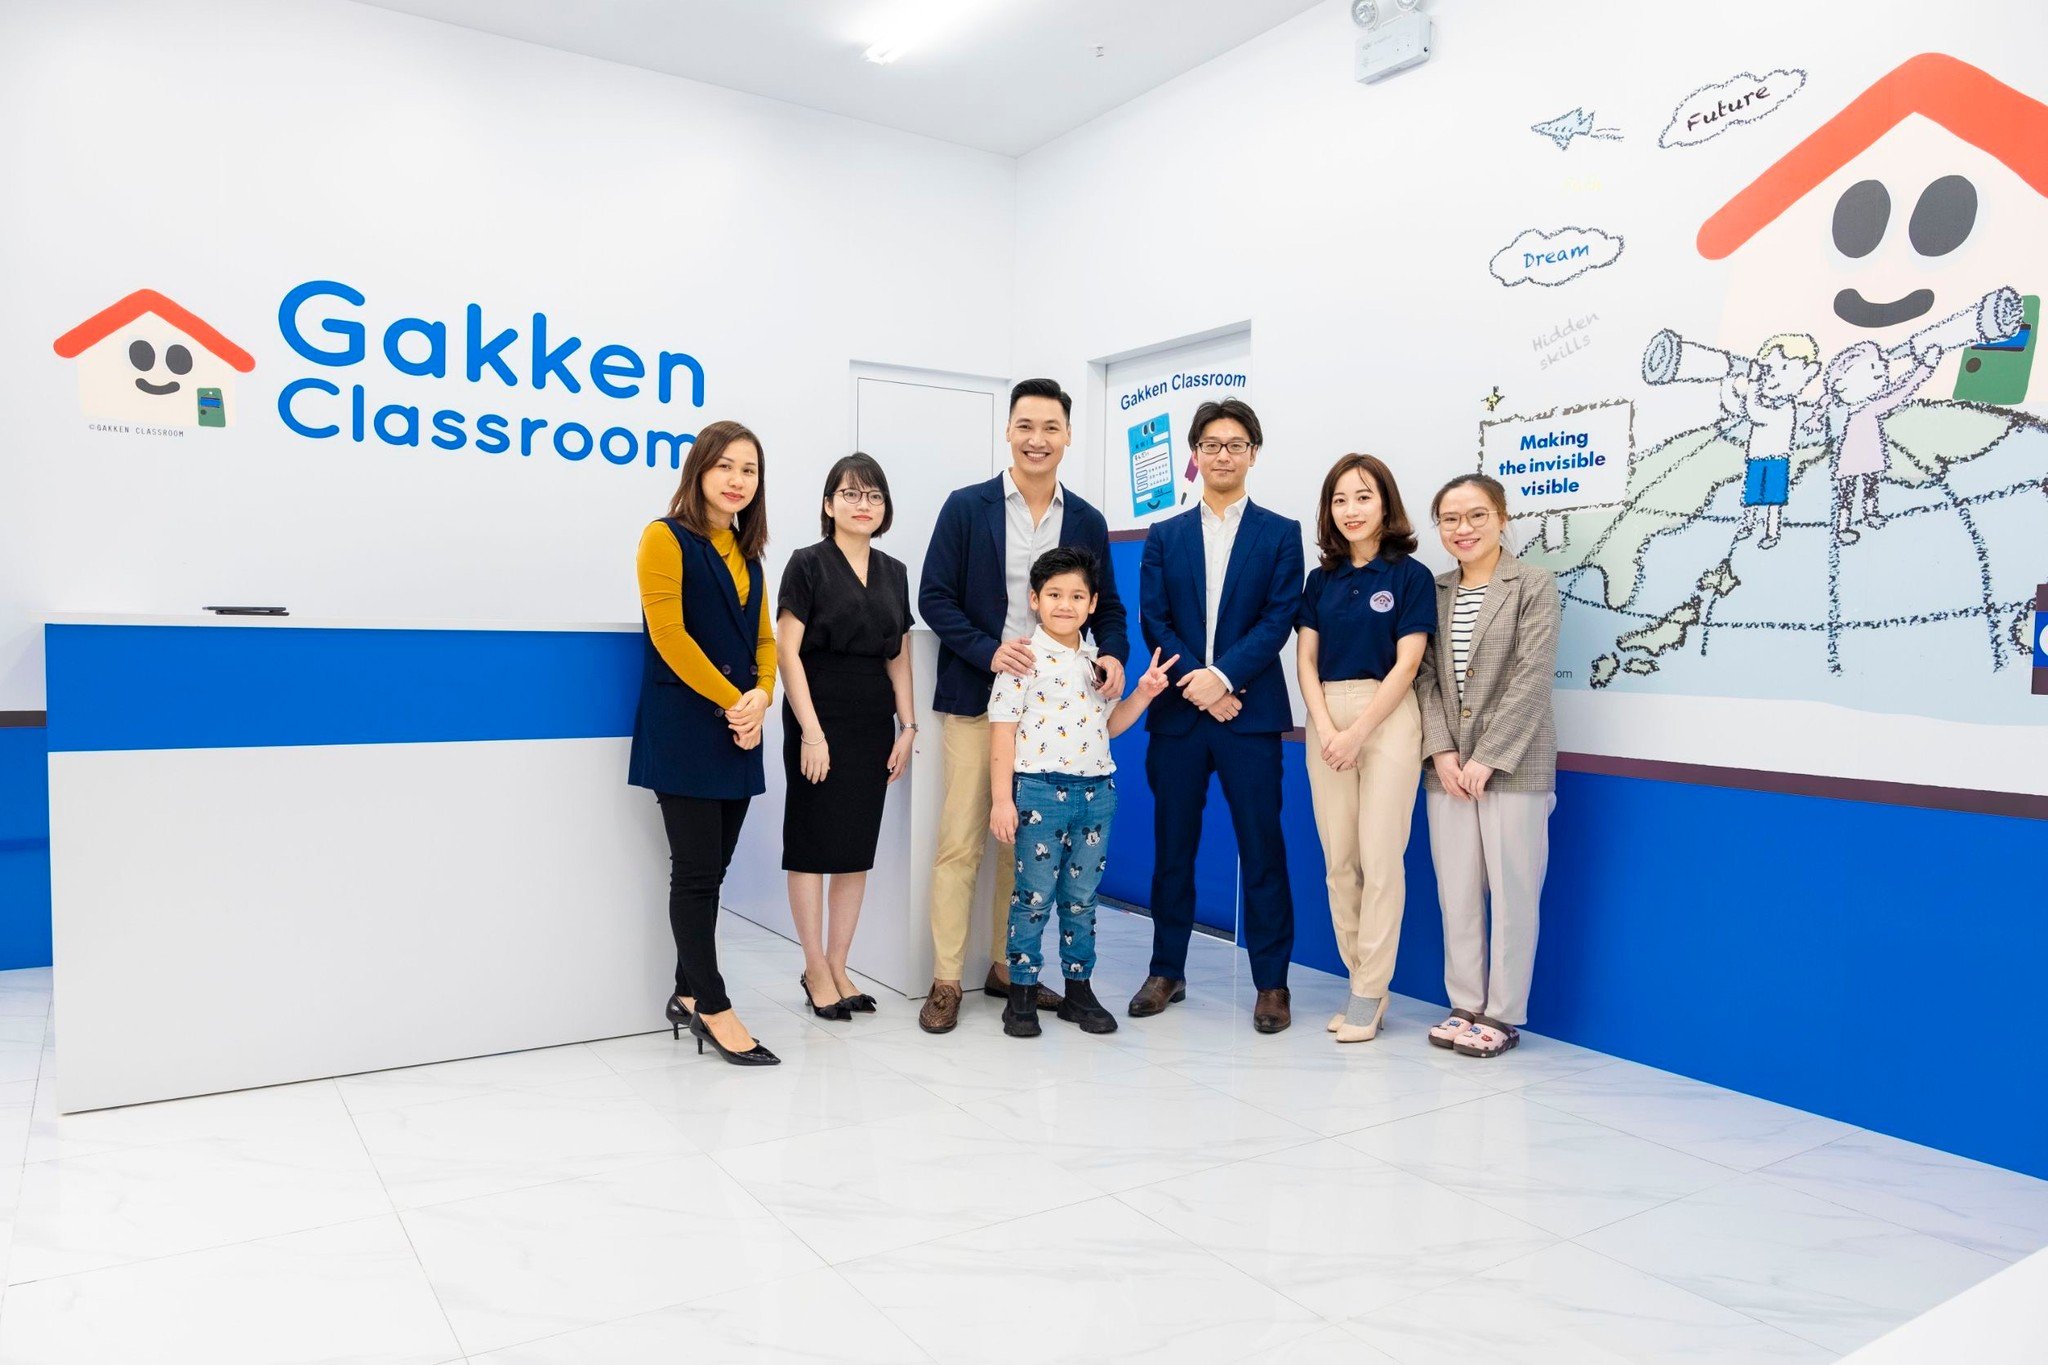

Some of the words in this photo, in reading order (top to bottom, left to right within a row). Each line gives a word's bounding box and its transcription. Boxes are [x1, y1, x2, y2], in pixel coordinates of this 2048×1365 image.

[1687, 86, 1770, 132] Future
[1524, 244, 1590, 268] Dream
[277, 279, 706, 408] Gakken
[1532, 312, 1600, 352] Hidden
[1540, 334, 1592, 371] skills
[1120, 381, 1168, 410] Gakken
[1171, 372, 1246, 391] Classroom
[135, 426, 184, 438] CLASSROOM
[276, 376, 697, 471] Classroom
[1519, 431, 1589, 451] Making
[1498, 460, 1527, 476] the
[1529, 451, 1607, 473] invisible
[1520, 477, 1580, 497] visible
